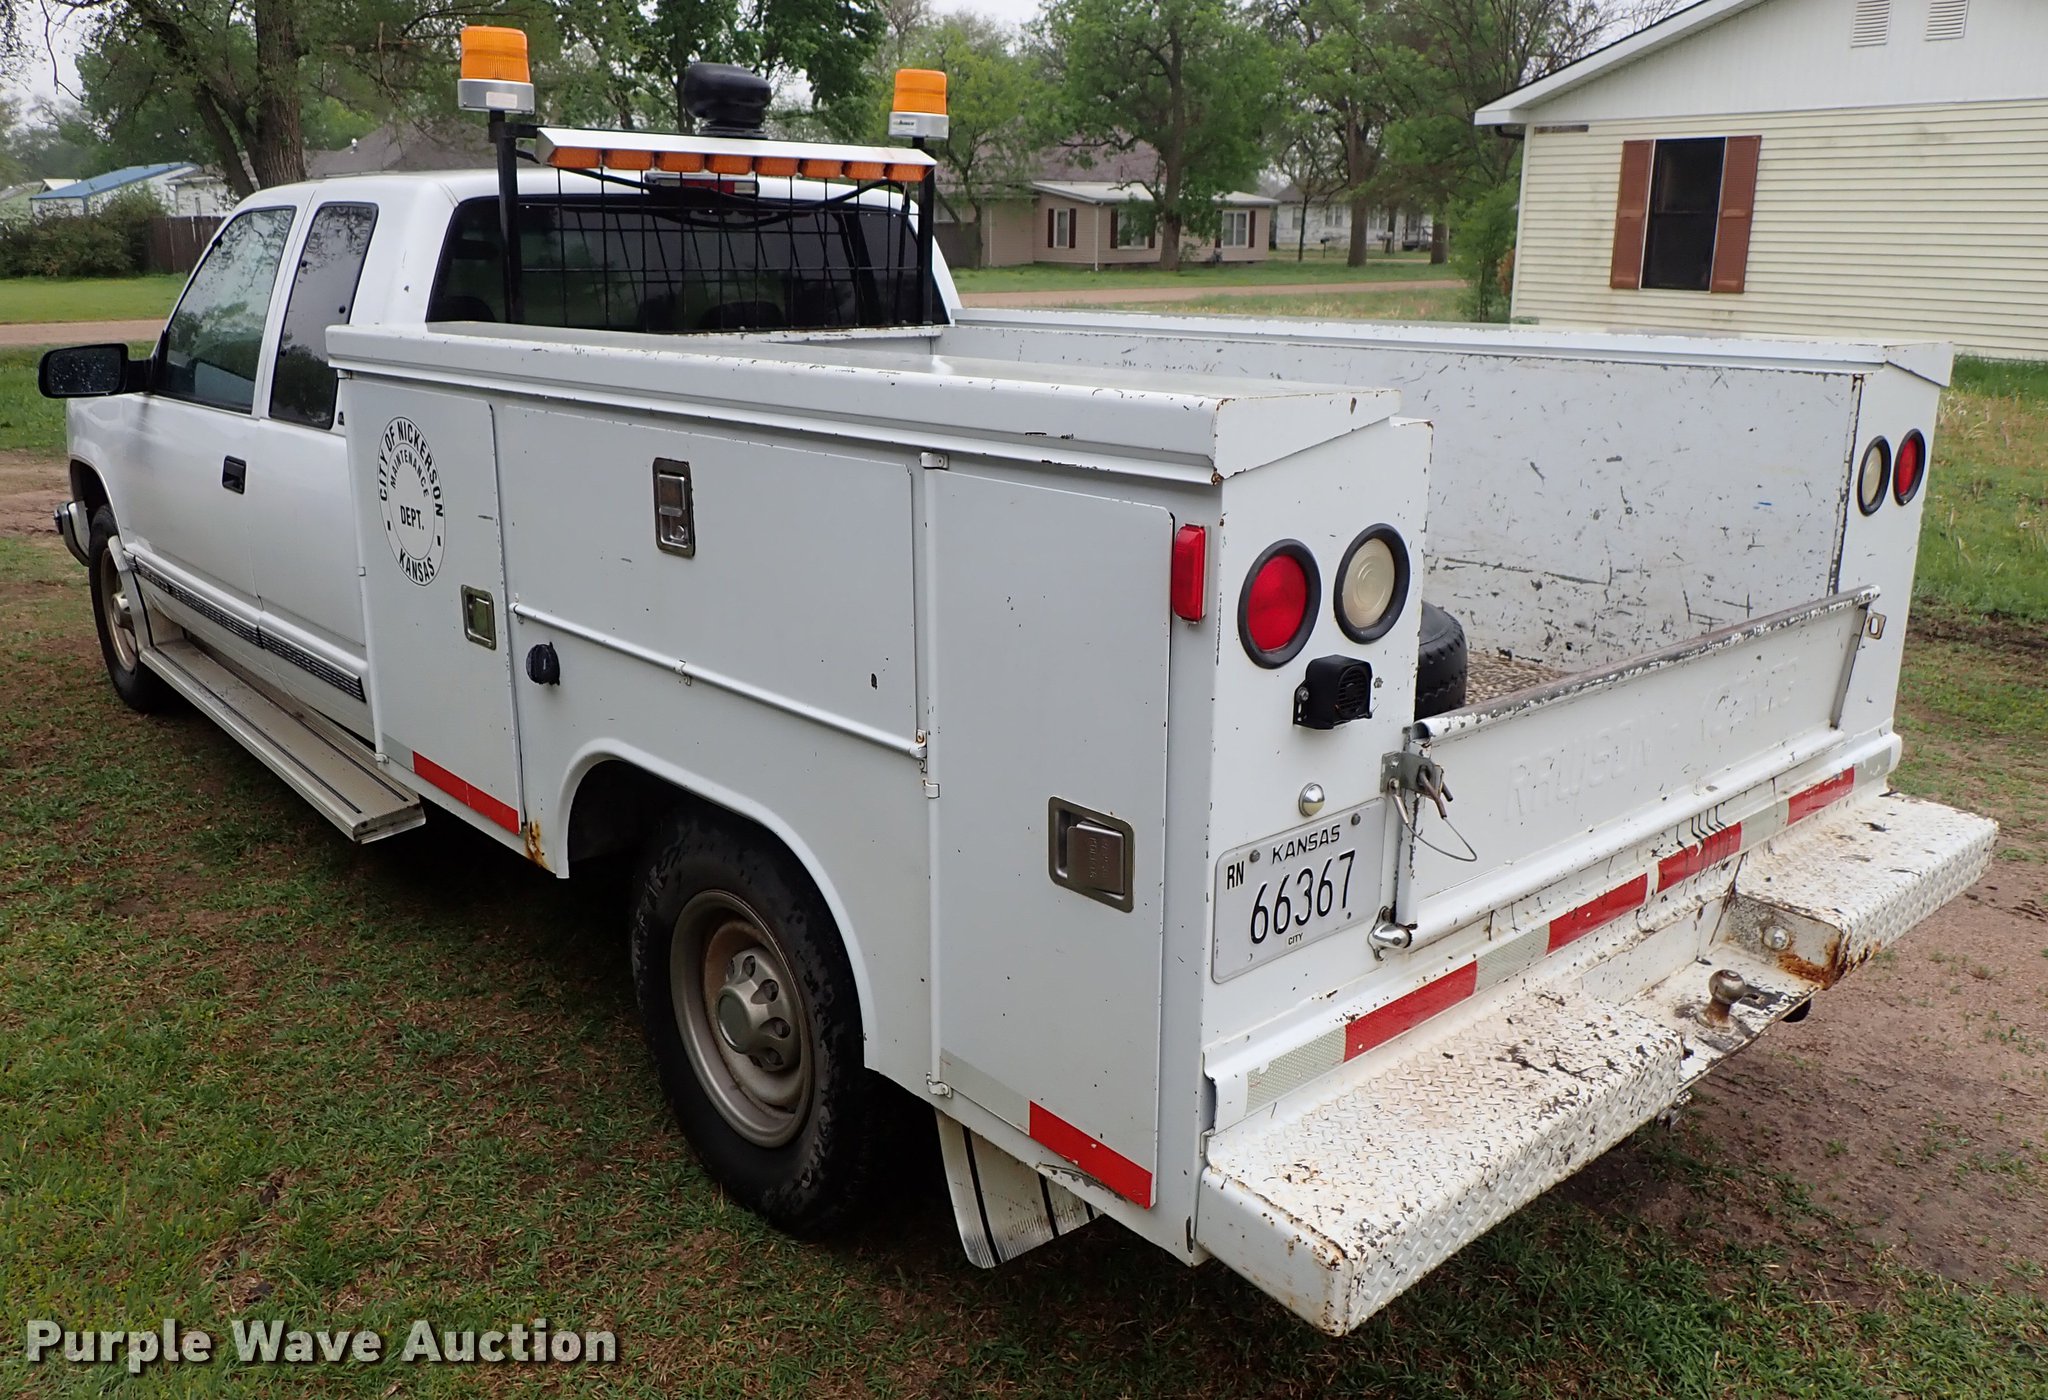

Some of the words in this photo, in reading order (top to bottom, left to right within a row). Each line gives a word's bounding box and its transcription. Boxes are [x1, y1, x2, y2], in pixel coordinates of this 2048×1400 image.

[379, 449, 388, 501] CITY
[385, 426, 395, 452] OF
[397, 421, 444, 518] NICKERSON
[390, 449, 430, 498] MAINTENANCE
[400, 505, 425, 530] DEPT.
[399, 548, 435, 583] KANSAS
[1271, 825, 1341, 864] KANSAS
[1226, 861, 1245, 890] RN
[1250, 850, 1356, 944] 66367
[1288, 932, 1304, 945] CITY
